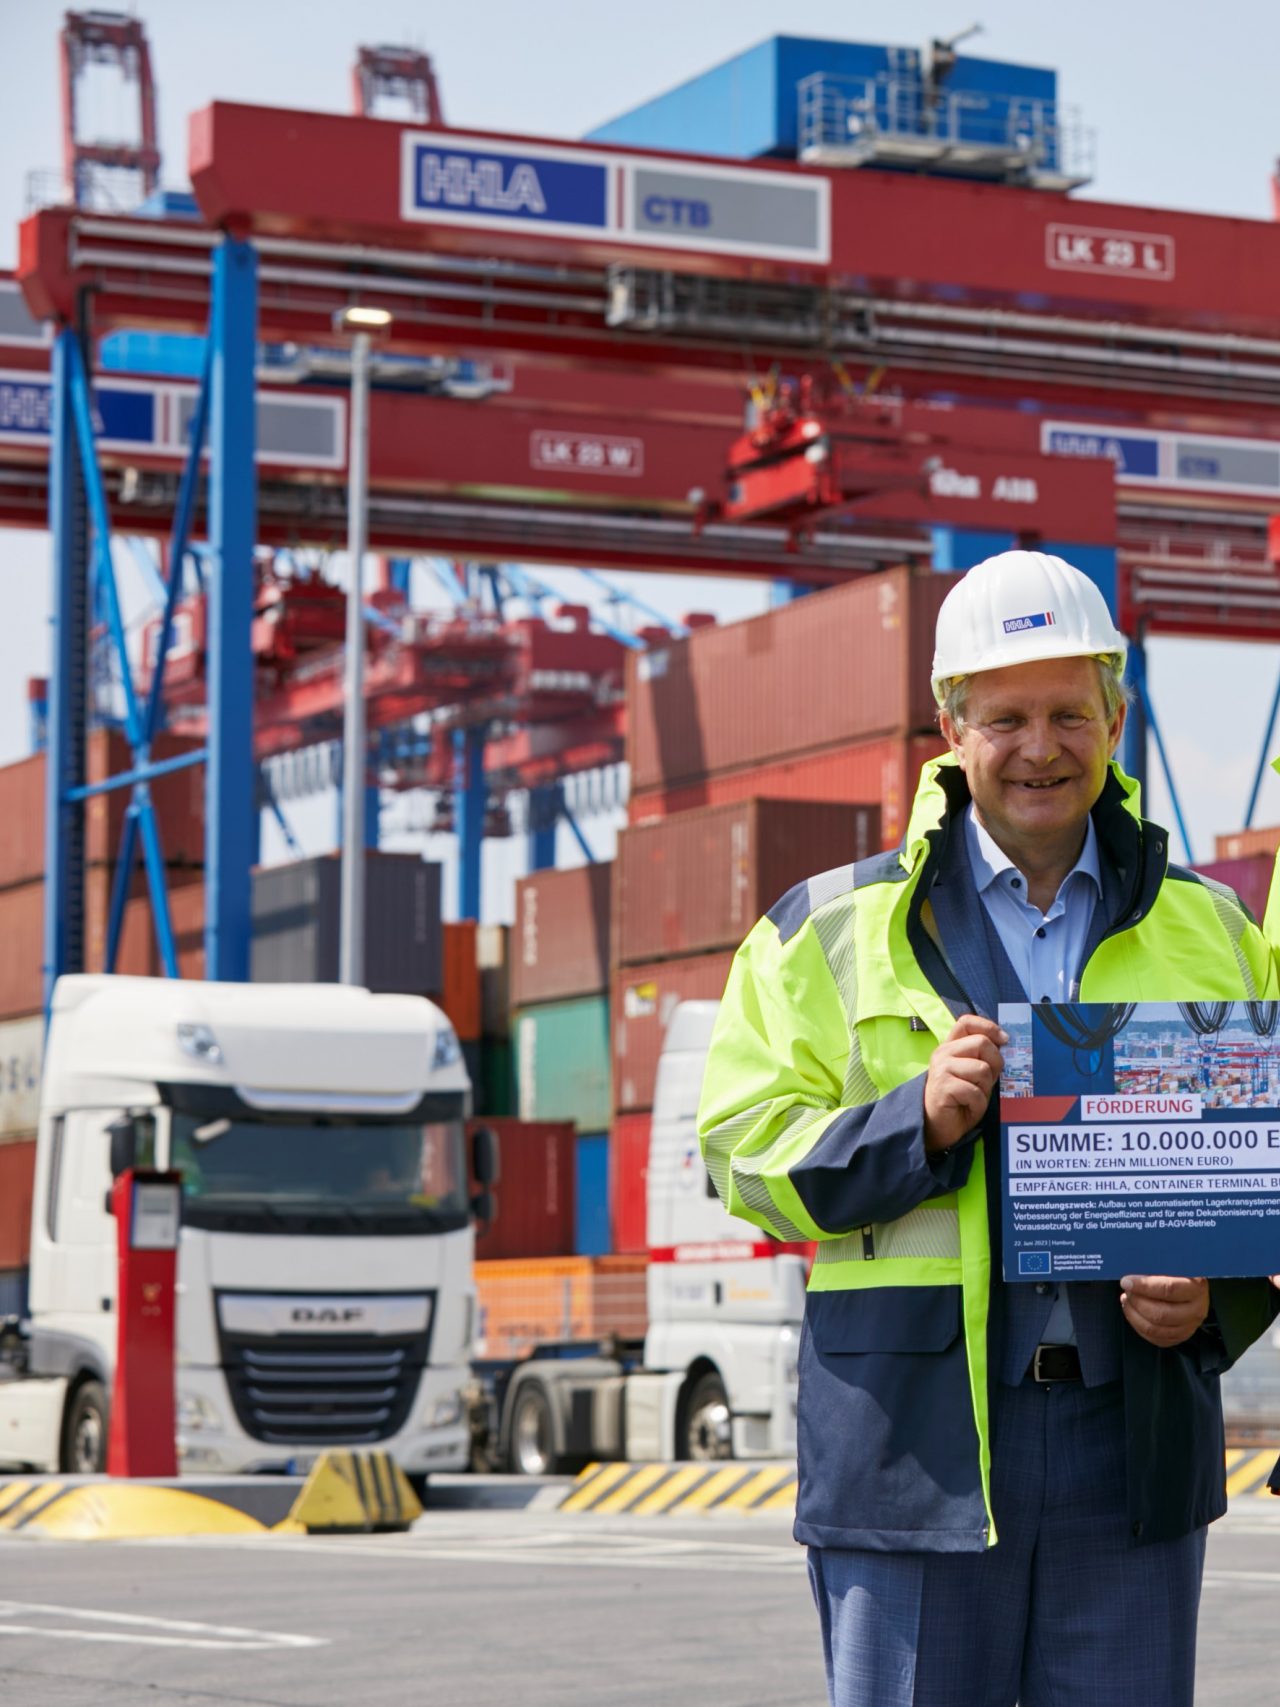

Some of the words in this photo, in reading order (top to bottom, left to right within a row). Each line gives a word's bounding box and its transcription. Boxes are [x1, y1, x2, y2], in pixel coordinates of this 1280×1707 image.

[421, 153, 546, 214] HHLA
[643, 194, 711, 228] CTB
[1057, 235, 1094, 262] LK
[1102, 239, 1136, 268] 23
[1142, 243, 1163, 271] L
[540, 441, 573, 464] LK
[1004, 618, 1034, 632] HHLA
[1086, 1097, 1193, 1114] FÖRDERUNG
[1016, 1132, 1113, 1153] SUMME:
[1121, 1130, 1258, 1151] 10.000.000
[1015, 1159, 1032, 1170] (IN
[1035, 1158, 1091, 1169] WORTEN:
[1094, 1158, 1126, 1168] ZEHN
[1129, 1156, 1194, 1167] MILLIONEN
[1197, 1155, 1233, 1167] EURO)
[1016, 1179, 1092, 1193] EMPFÄNGER:
[1095, 1180, 1130, 1192] HHLA,
[1134, 1179, 1203, 1190] CONTAINER
[1208, 1178, 1267, 1189] TERMINAL
[1014, 1201, 1097, 1211] Verwendungszweck:
[1098, 1200, 1126, 1208] Aufbau
[1145, 1199, 1204, 1207] automatisierten
[1014, 1211, 1067, 1221] Verbesserung
[1069, 1211, 1082, 1219] der
[1084, 1210, 1146, 1220] Energieeffizienz
[1148, 1210, 1163, 1218] und
[1165, 1210, 1176, 1218] für
[1196, 1208, 1264, 1218] Dekarbonisierung
[1014, 1222, 1072, 1231] Voraussetzung
[1073, 1221, 1084, 1229] für
[1086, 1221, 1098, 1229] die
[1100, 1220, 1143, 1230] Umrüstung
[1145, 1220, 1157, 1228] auf
[1159, 1219, 1216, 1228] B-AGV-Betrieb
[292, 1307, 363, 1321] DAF
